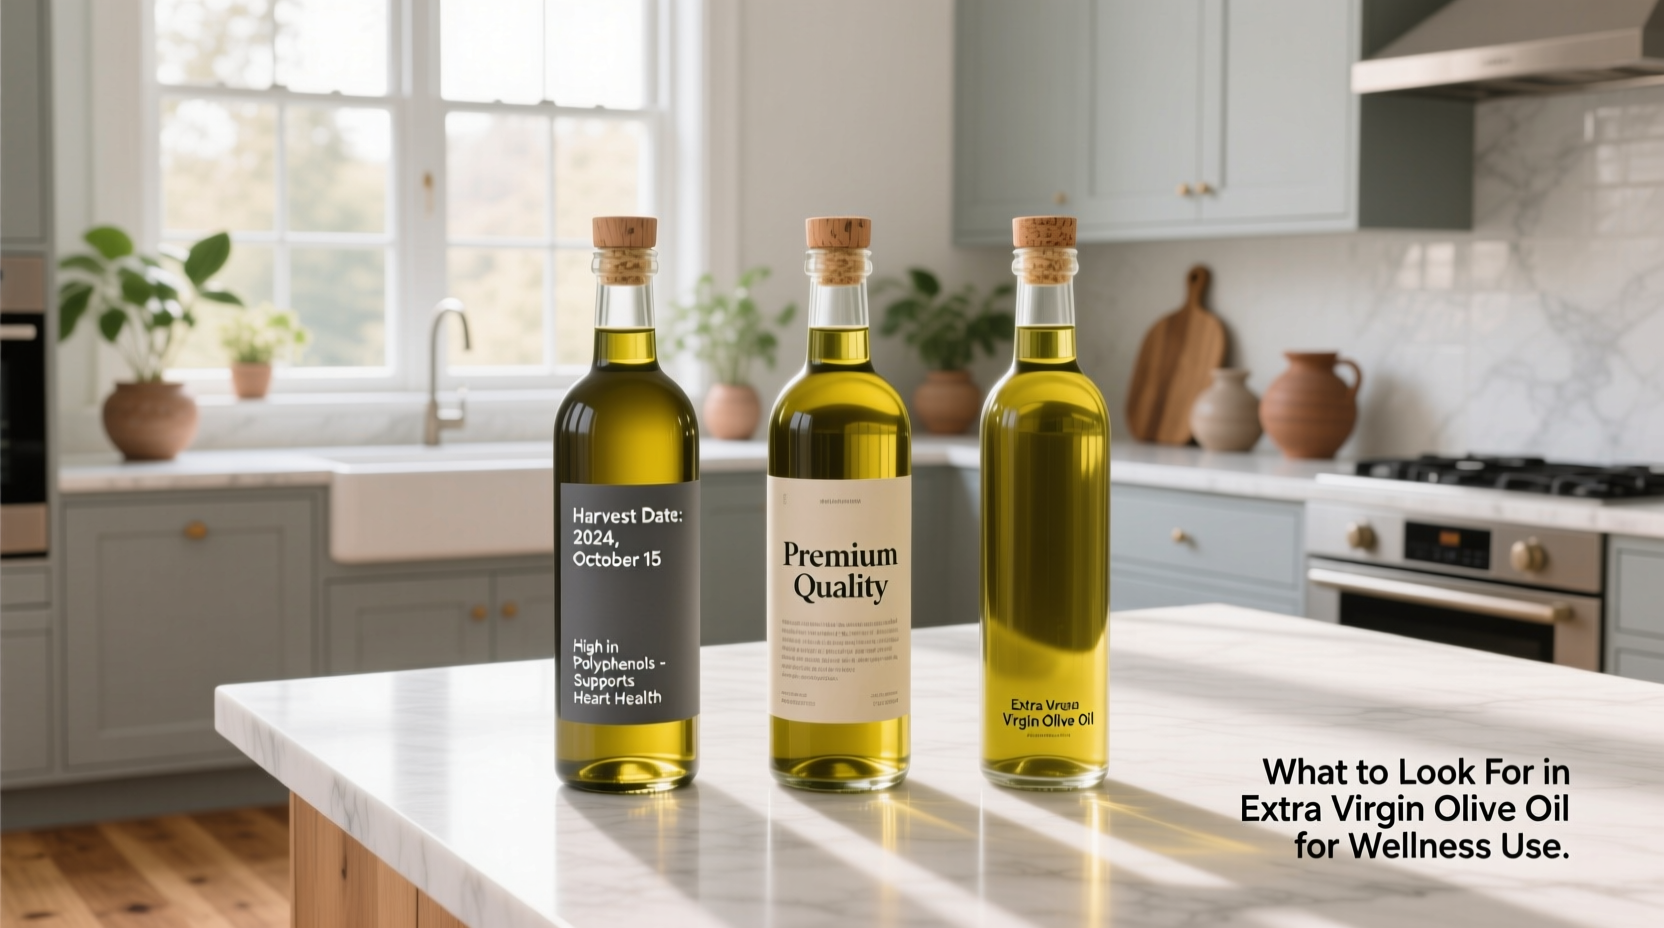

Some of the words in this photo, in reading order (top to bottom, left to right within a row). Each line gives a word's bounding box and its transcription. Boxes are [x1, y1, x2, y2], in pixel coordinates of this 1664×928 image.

[572, 507, 637, 524] Harvest
[641, 507, 683, 523] Date:
[573, 529, 620, 548] 2024,
[572, 550, 640, 567] October
[643, 550, 662, 567] 15
[782, 541, 898, 568] Premium
[793, 572, 889, 606] Quality
[573, 639, 603, 656] High
[606, 639, 619, 654] in
[573, 656, 656, 674] Polyphenols
[574, 674, 635, 691] Supports
[574, 690, 611, 705] Heart
[615, 689, 662, 705] Health
[1042, 714, 1075, 728] Olive
[1078, 711, 1094, 726] Oil
